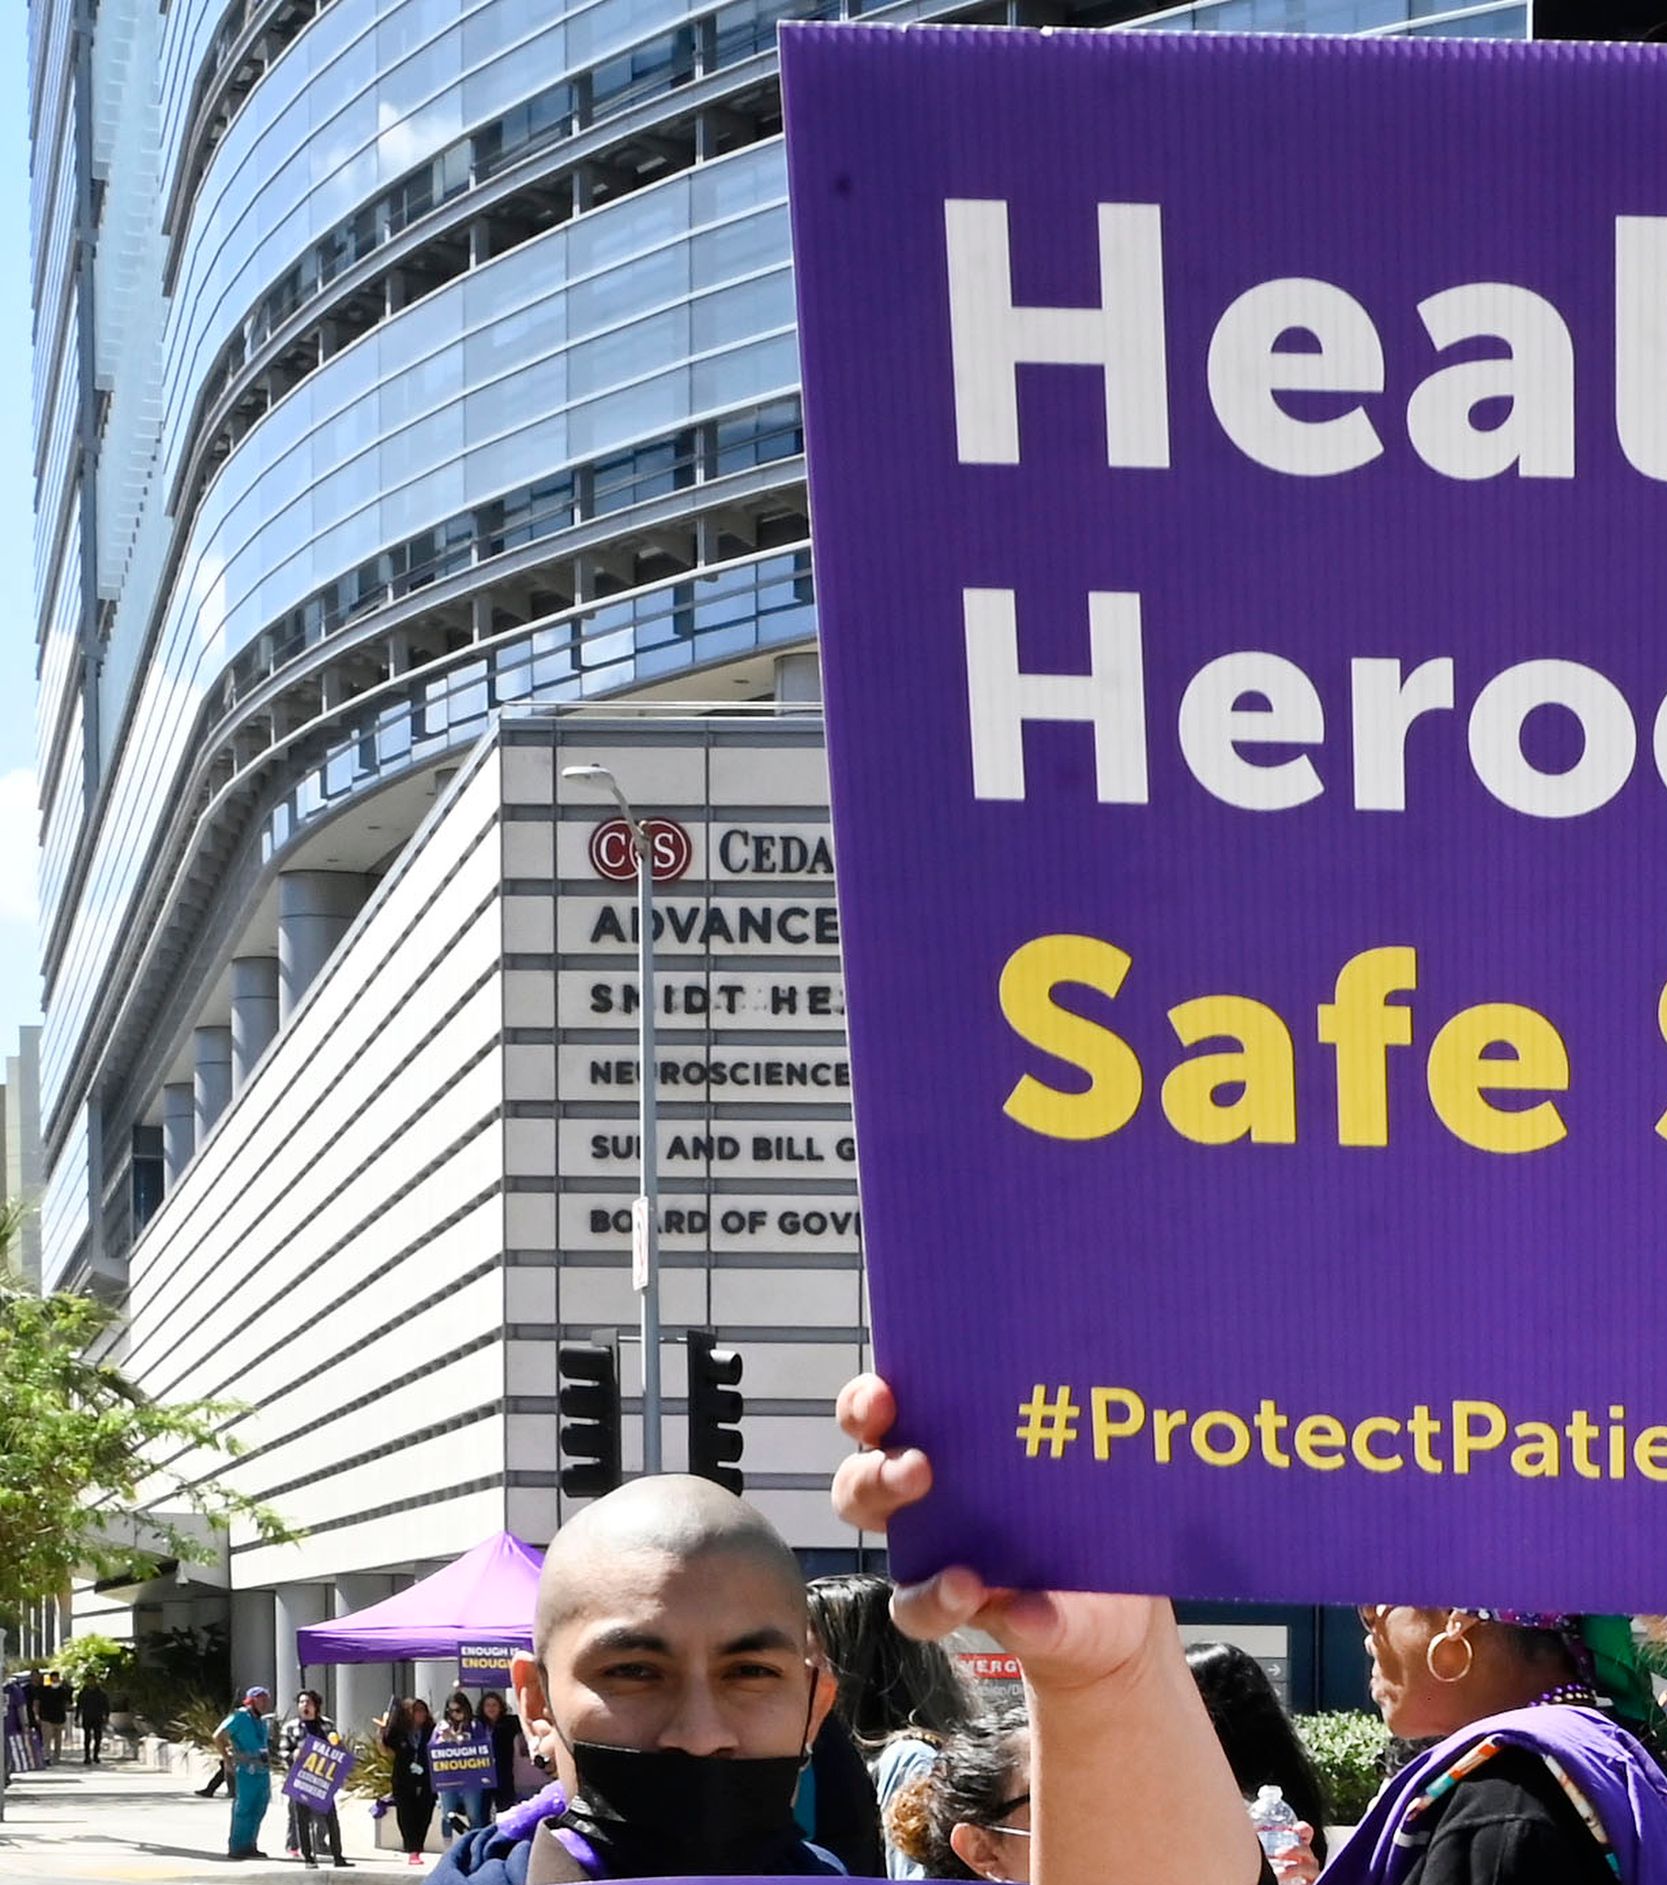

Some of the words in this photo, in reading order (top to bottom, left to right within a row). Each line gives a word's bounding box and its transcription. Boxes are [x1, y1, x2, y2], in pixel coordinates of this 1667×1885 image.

[771, 985, 846, 1015] HE
[999, 934, 1569, 1154] Safe
[590, 1061, 850, 1087] NEROSCIENCE
[591, 1135, 643, 1160] SU
[666, 1135, 741, 1161] AND
[752, 1136, 825, 1161] BILL
[590, 1209, 710, 1234] BORD
[720, 1210, 768, 1234] OF
[778, 1211, 862, 1236] GOV
[462, 1658, 510, 1668] ENOUG
[313, 1740, 346, 1763] VALUE
[431, 1746, 477, 1759] ENOUGH
[478, 1745, 488, 1755] IS
[433, 1757, 491, 1772] ENOUGH!
[303, 1752, 336, 1781] ALL
